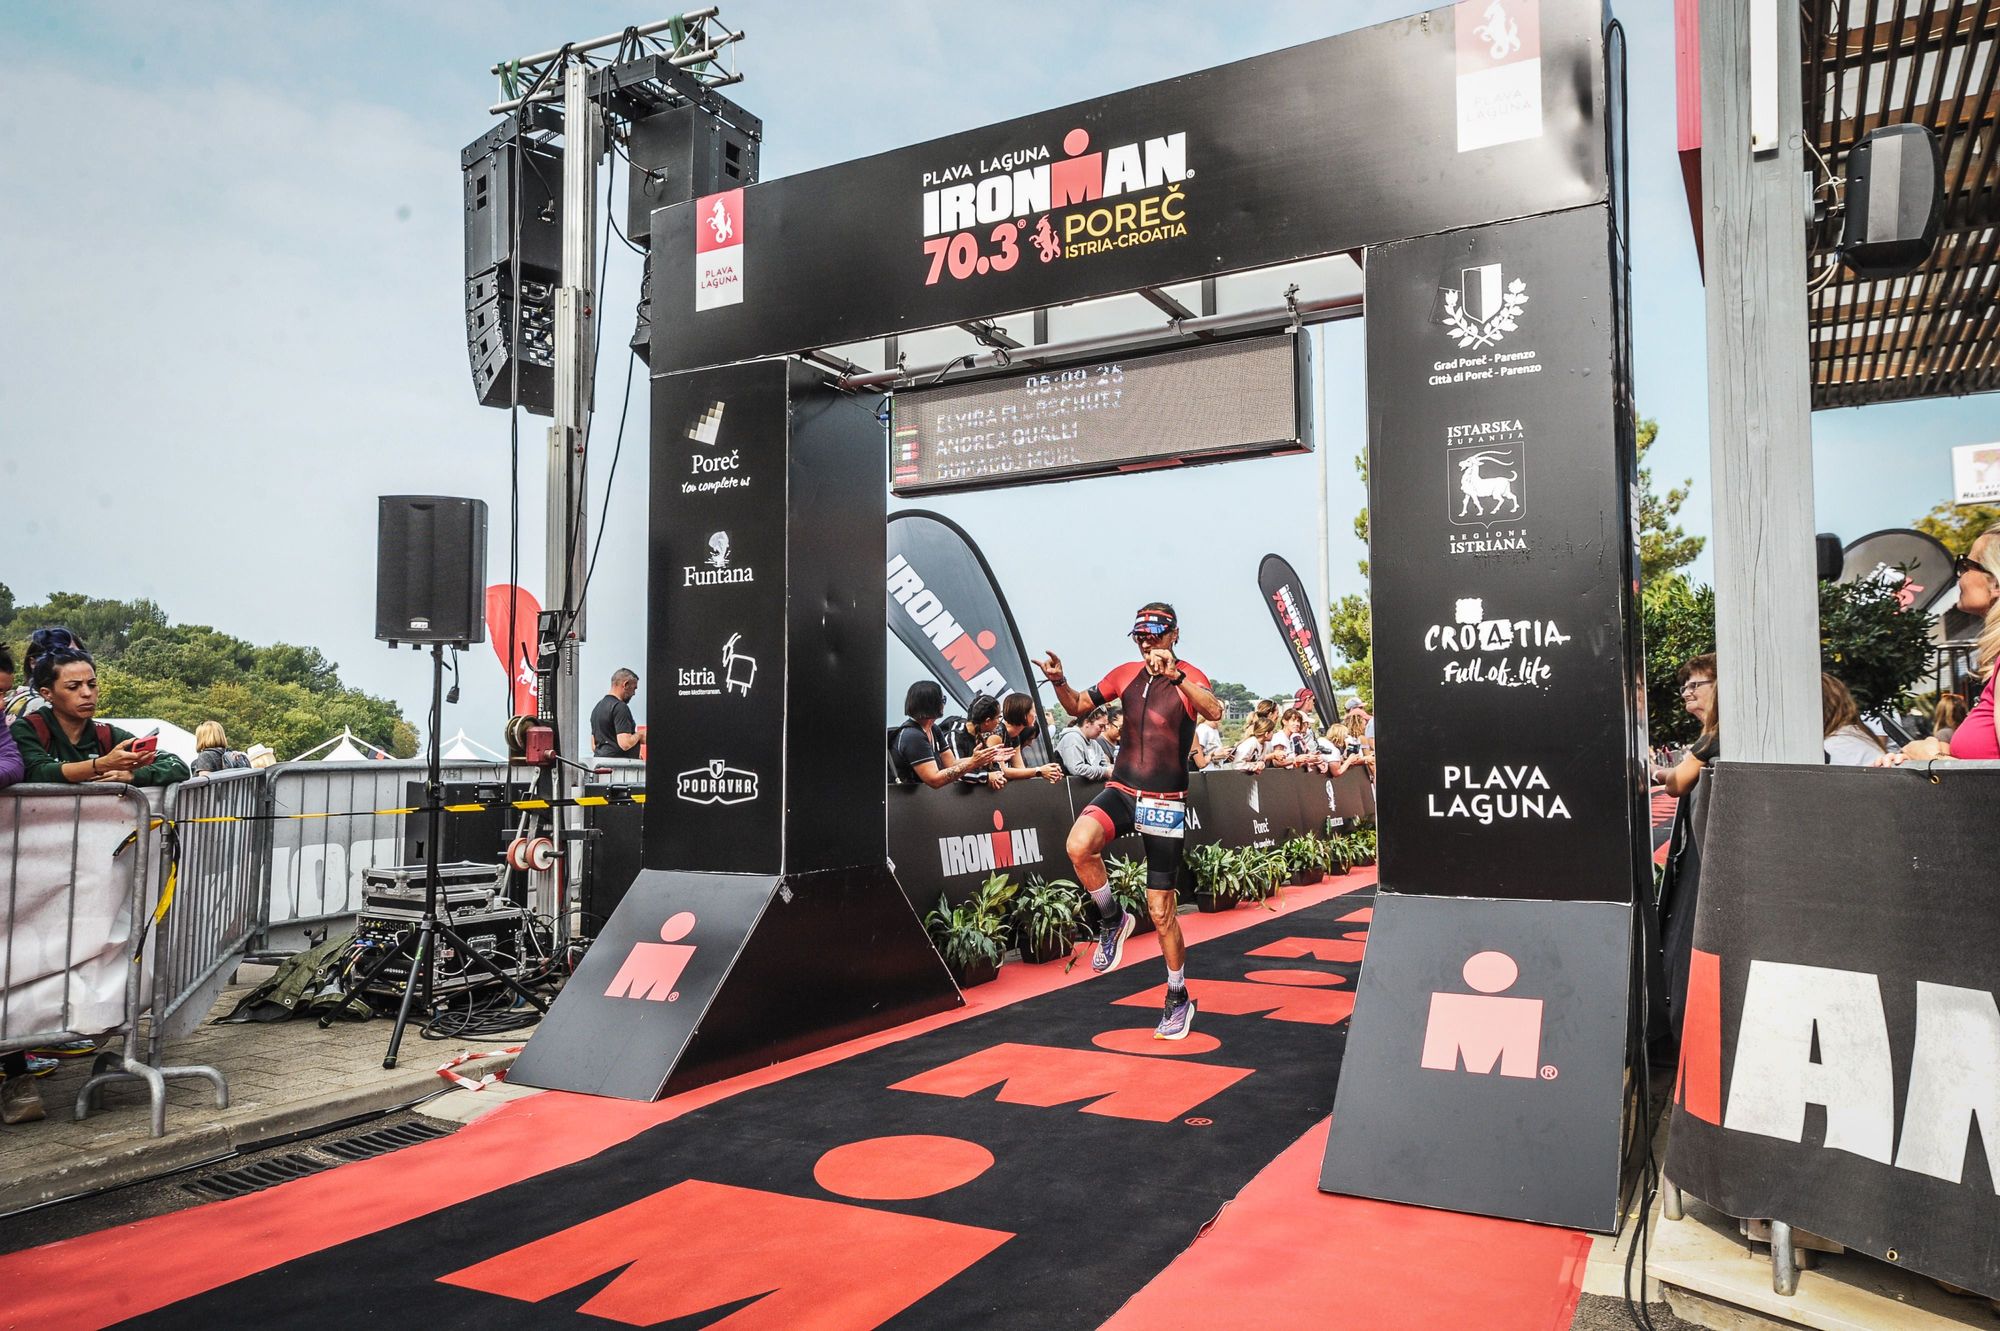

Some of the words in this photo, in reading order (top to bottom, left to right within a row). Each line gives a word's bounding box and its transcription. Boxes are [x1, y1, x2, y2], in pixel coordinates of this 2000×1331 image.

[923, 164, 973, 187] PLAVA
[980, 145, 1050, 171] LAGUNA
[1065, 184, 1186, 243] POREČ
[1065, 222, 1187, 259] ISTRIA-CROATIA
[701, 275, 738, 289] LAGUNA
[705, 266, 733, 278] PLAVA
[1434, 359, 1458, 371] Grad
[1459, 355, 1487, 368] Poreč
[1494, 350, 1536, 363] Parenzo
[1428, 373, 1452, 385] Città
[1453, 372, 1463, 382] di
[1465, 368, 1493, 381] Poreč
[1500, 364, 1542, 376] Parenzo
[1447, 419, 1523, 438] ISTARSKA
[691, 449, 739, 474] Poreč
[682, 482, 697, 493] You
[698, 477, 738, 494] complete
[740, 477, 751, 486] us
[1449, 529, 1526, 541] REGIONE
[1450, 537, 1526, 553] ISTRIANA
[683, 566, 754, 587] Funtana
[1424, 619, 1571, 652] CROATIA
[678, 667, 715, 686] Istria
[683, 779, 752, 793] PODRAVKA
[1444, 765, 1550, 789] PLAVA
[1147, 809, 1175, 824] 835
[1428, 794, 1571, 825] LAGUNA
